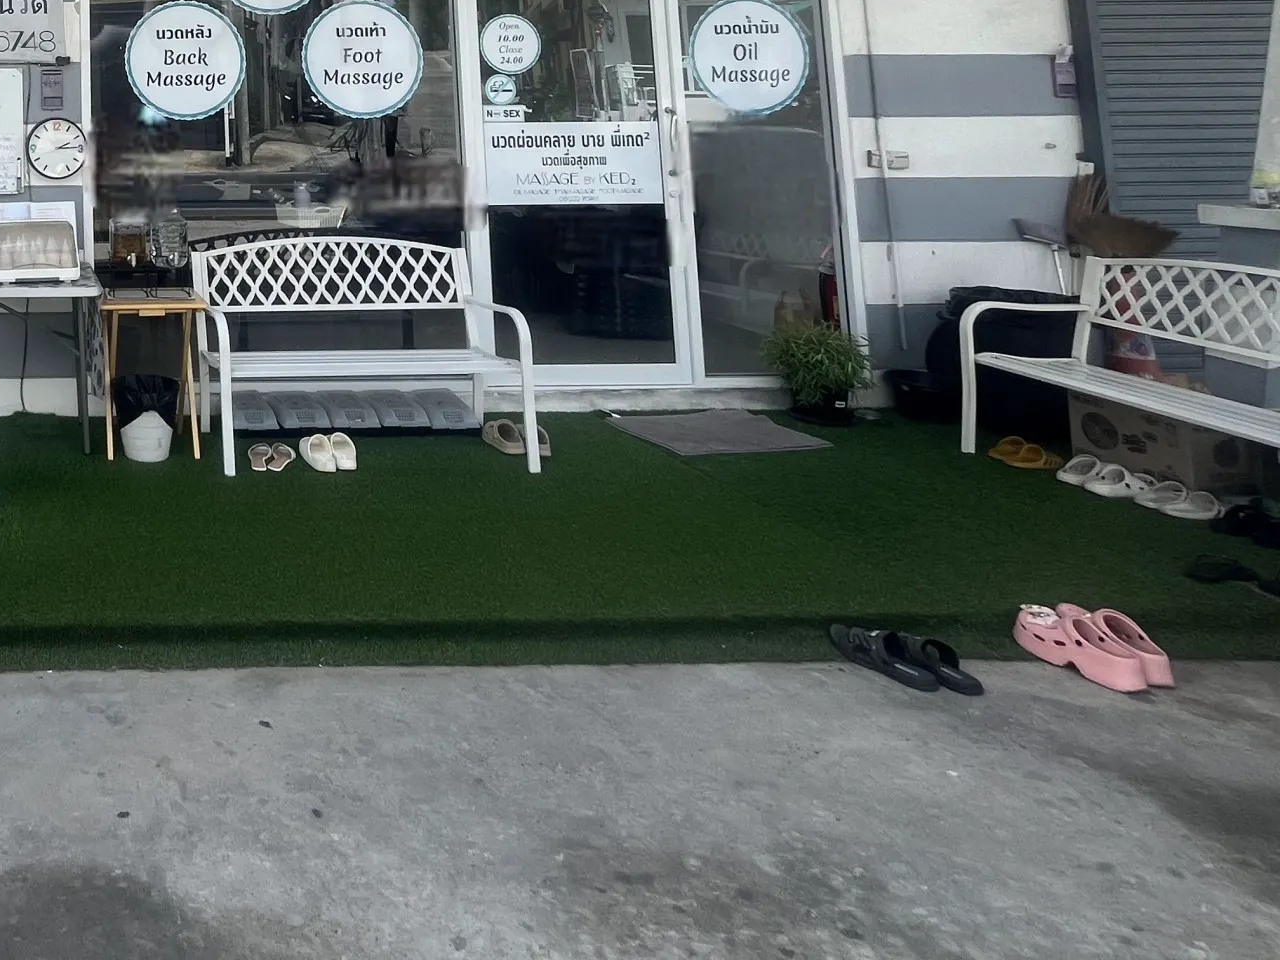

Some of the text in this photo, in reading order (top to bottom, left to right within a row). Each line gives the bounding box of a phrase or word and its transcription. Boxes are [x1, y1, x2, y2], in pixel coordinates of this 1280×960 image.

[156, 24, 213, 40] นวดหลัง
[335, 22, 386, 38] นวดเท้า
[499, 22, 520, 31] Open
[714, 15, 780, 35] นวดน้ำมัน
[497, 34, 524, 43] 10.00
[163, 47, 209, 66] Back
[342, 48, 383, 63] Foot
[498, 45, 523, 54] Close
[733, 42, 758, 61] Oil
[500, 56, 524, 64] 24.00
[146, 71, 227, 92] Massage
[323, 69, 404, 90] Massage
[711, 65, 790, 88] Massage
[503, 109, 521, 118] SEX
[52, 121, 62, 131] 12
[491, 130, 575, 148] นวดผ่อนคลาย
[581, 135, 604, 148] บาย
[30, 144, 84, 153] 9 3
[541, 149, 607, 170] นวดเพื่อสุขภาพ
[516, 172, 579, 186] MASSAGE
[584, 176, 596, 185] BY
